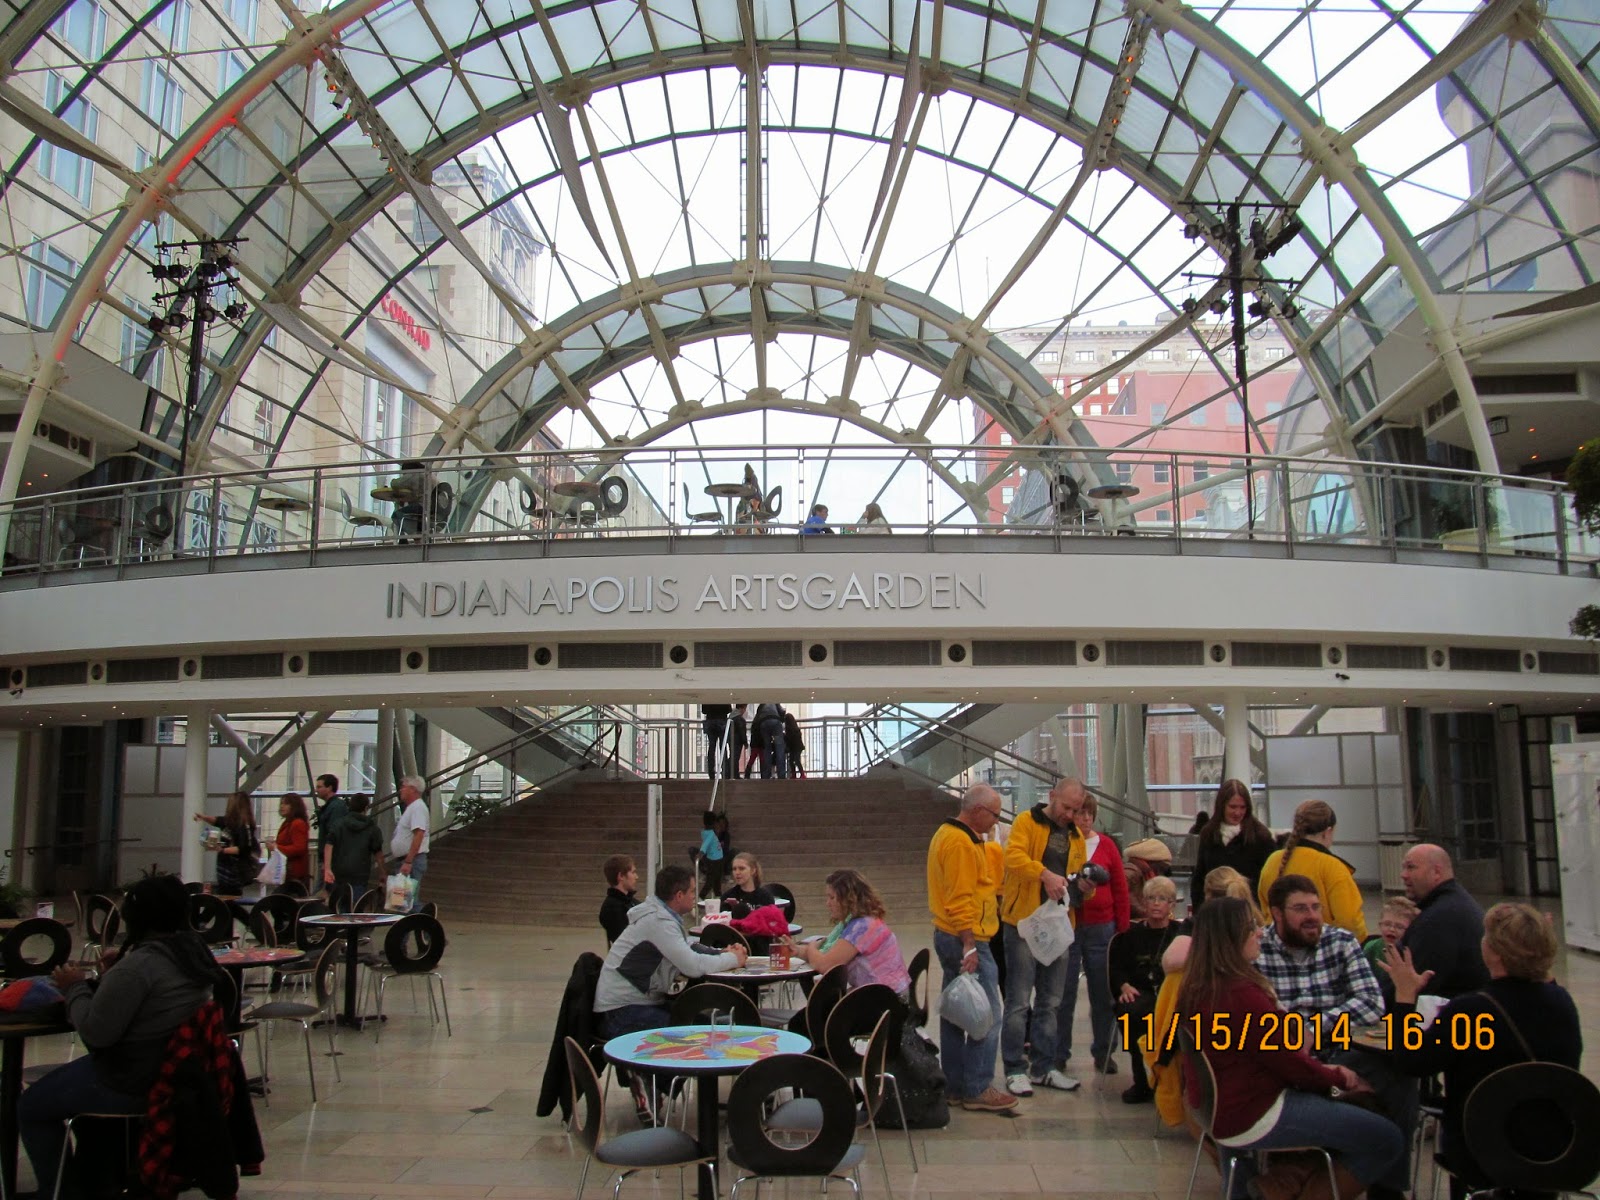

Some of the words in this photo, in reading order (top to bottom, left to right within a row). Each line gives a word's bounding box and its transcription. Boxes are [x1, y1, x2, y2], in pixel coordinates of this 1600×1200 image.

[381, 292, 431, 351] CONRAD
[387, 576, 680, 618] INDIANAPOLIS
[695, 572, 986, 611] ARTSGARDEN
